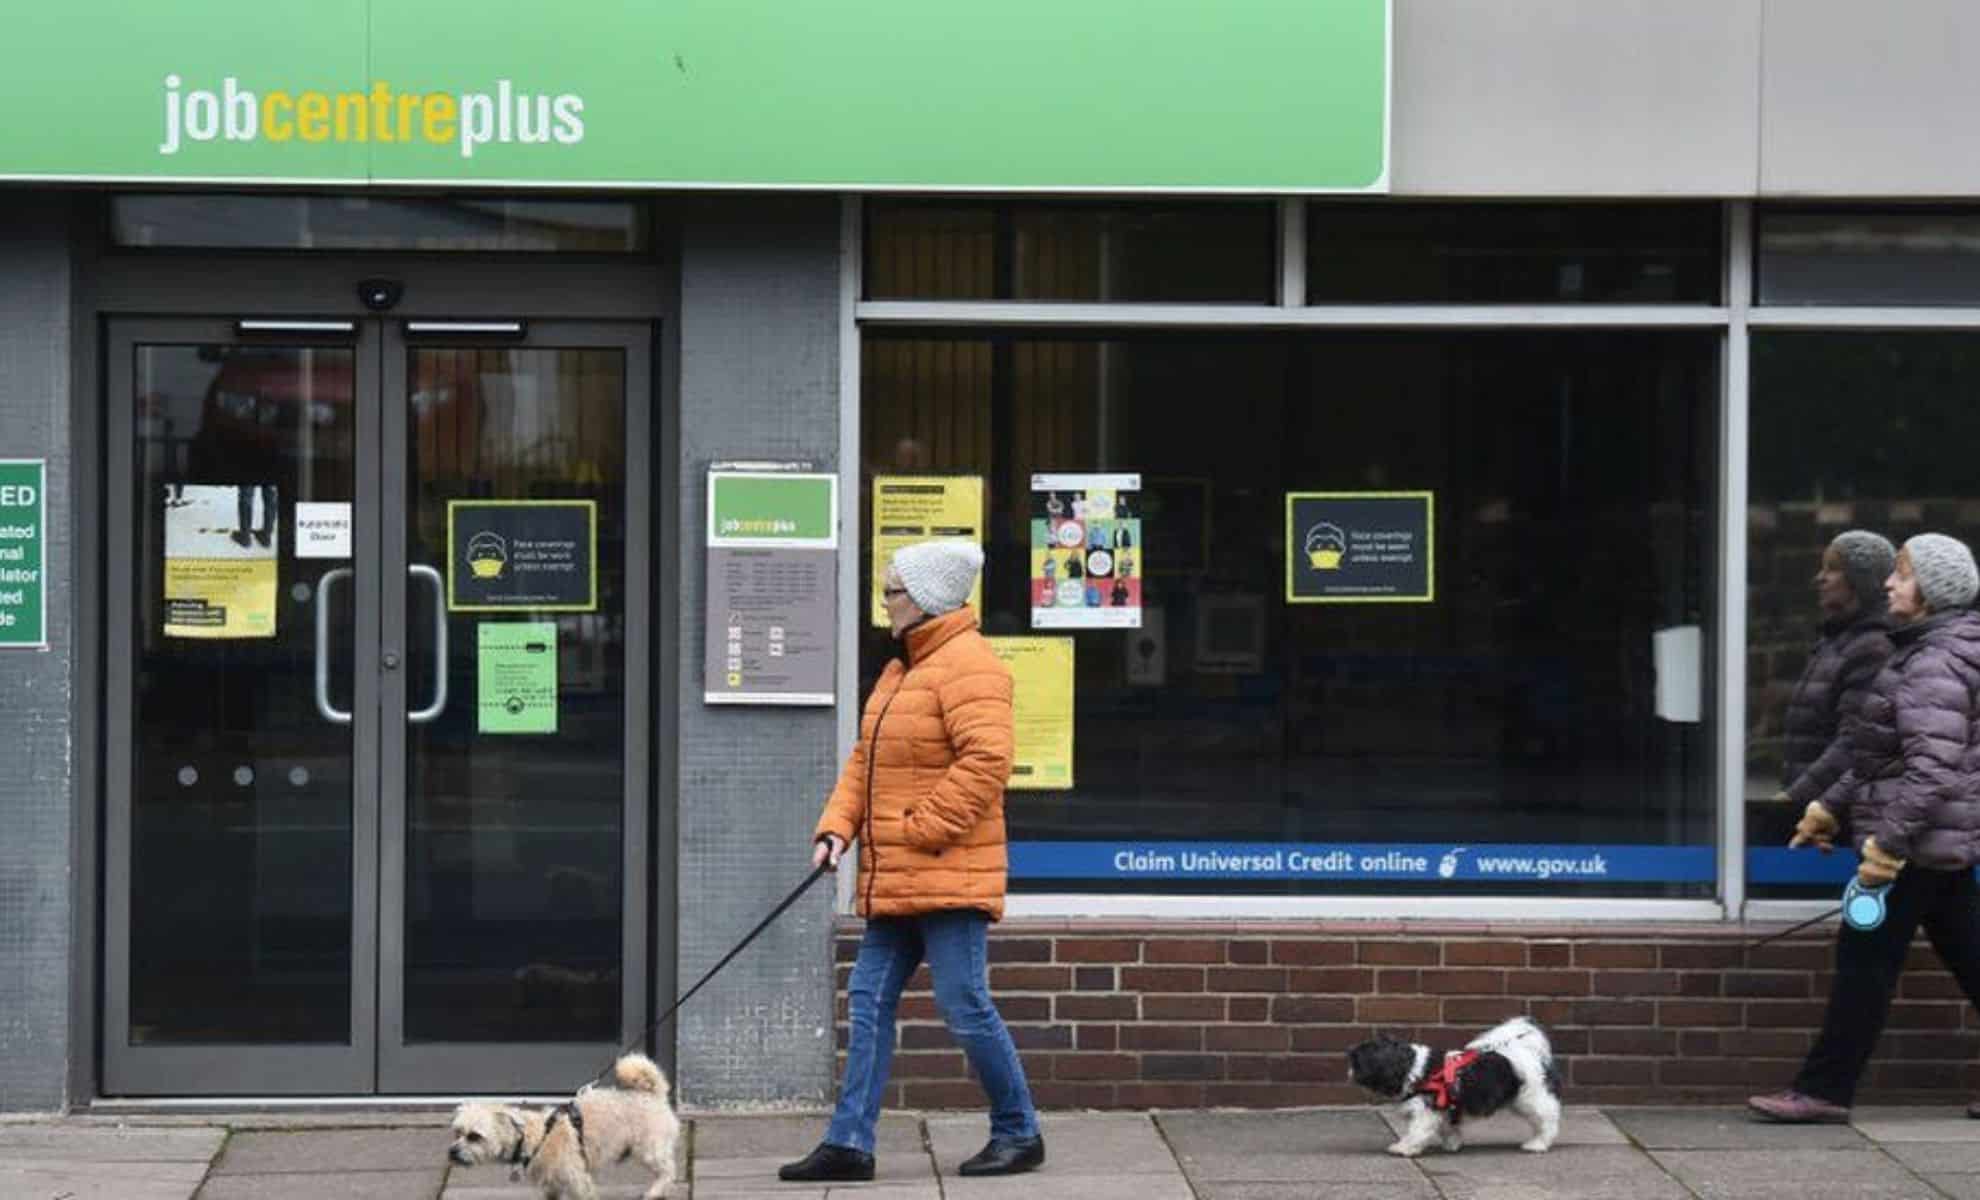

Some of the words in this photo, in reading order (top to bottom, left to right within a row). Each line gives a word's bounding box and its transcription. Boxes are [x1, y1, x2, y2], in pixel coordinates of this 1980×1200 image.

[160, 74, 585, 157] jobcentreplus
[0, 485, 36, 506] ED
[1114, 851, 1175, 871] Claim
[1181, 851, 1283, 871] Universal
[1288, 851, 1353, 871] Credit
[1360, 852, 1427, 872] online
[1476, 854, 1607, 878] www.gov.uk
